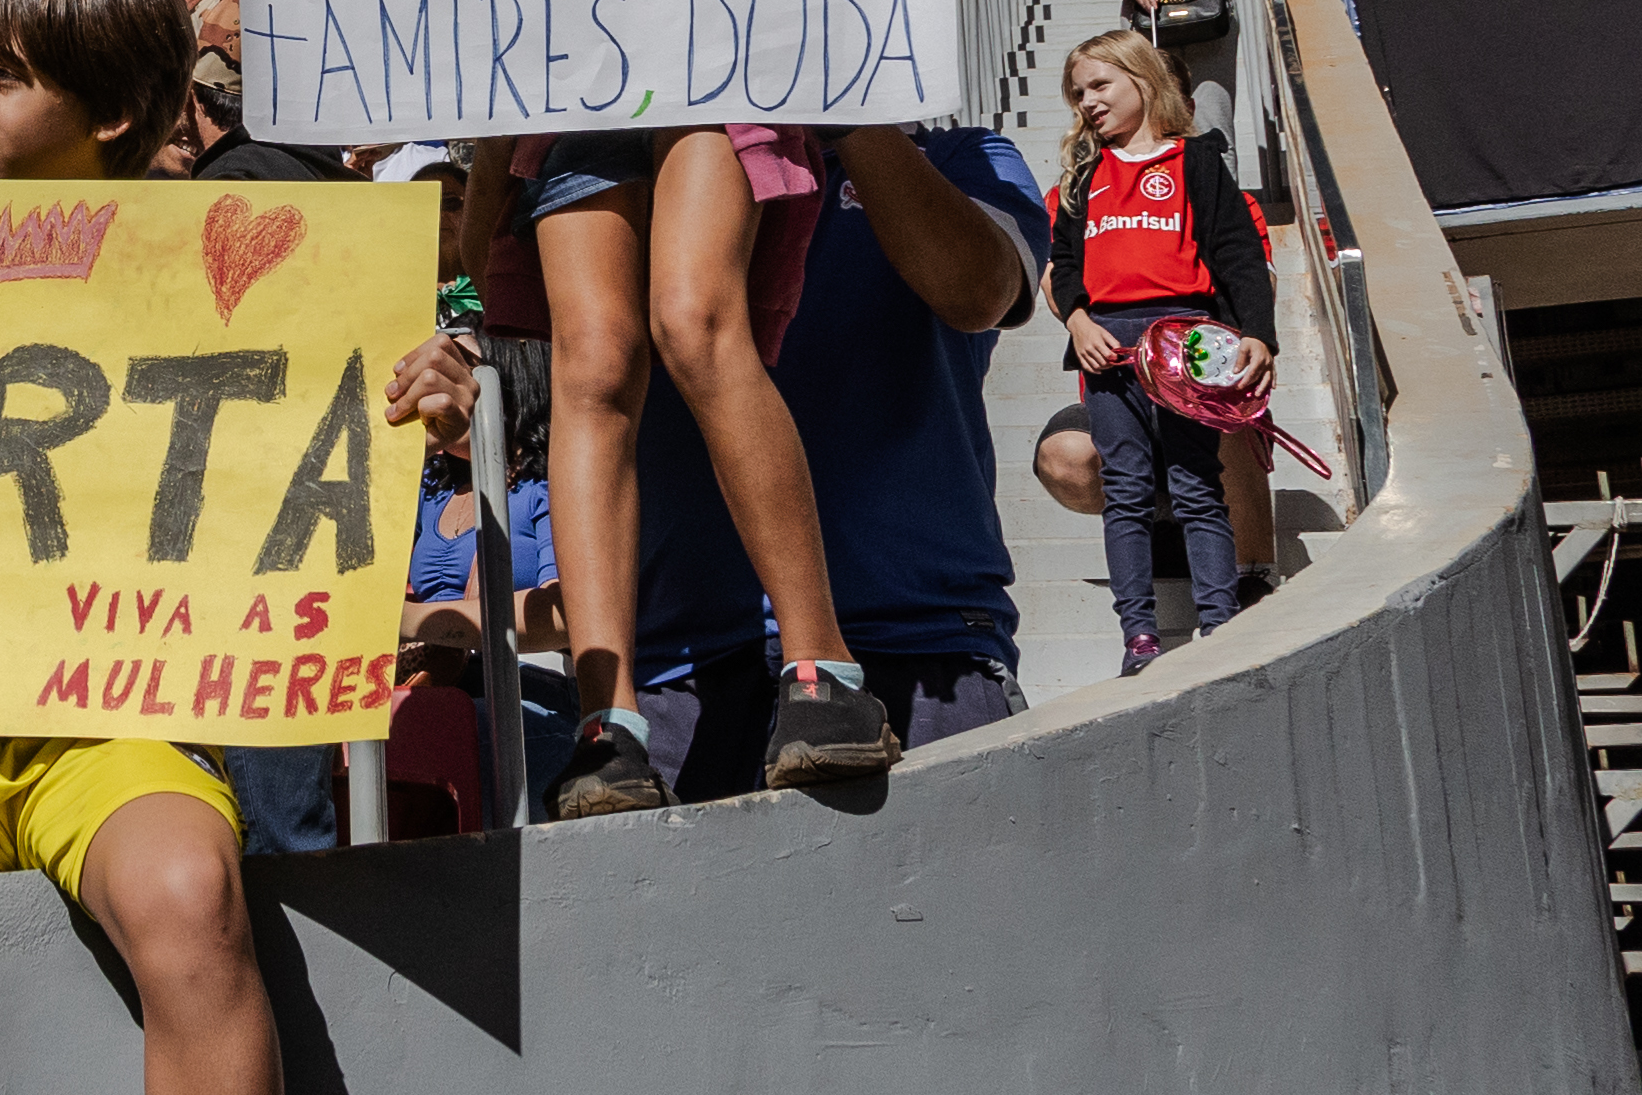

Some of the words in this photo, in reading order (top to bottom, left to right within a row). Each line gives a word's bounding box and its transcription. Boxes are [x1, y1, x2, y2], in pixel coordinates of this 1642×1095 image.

[1098, 210, 1181, 235] Banrisul
[66, 581, 192, 639] VIVA
[36, 653, 395, 719] MULHERES
